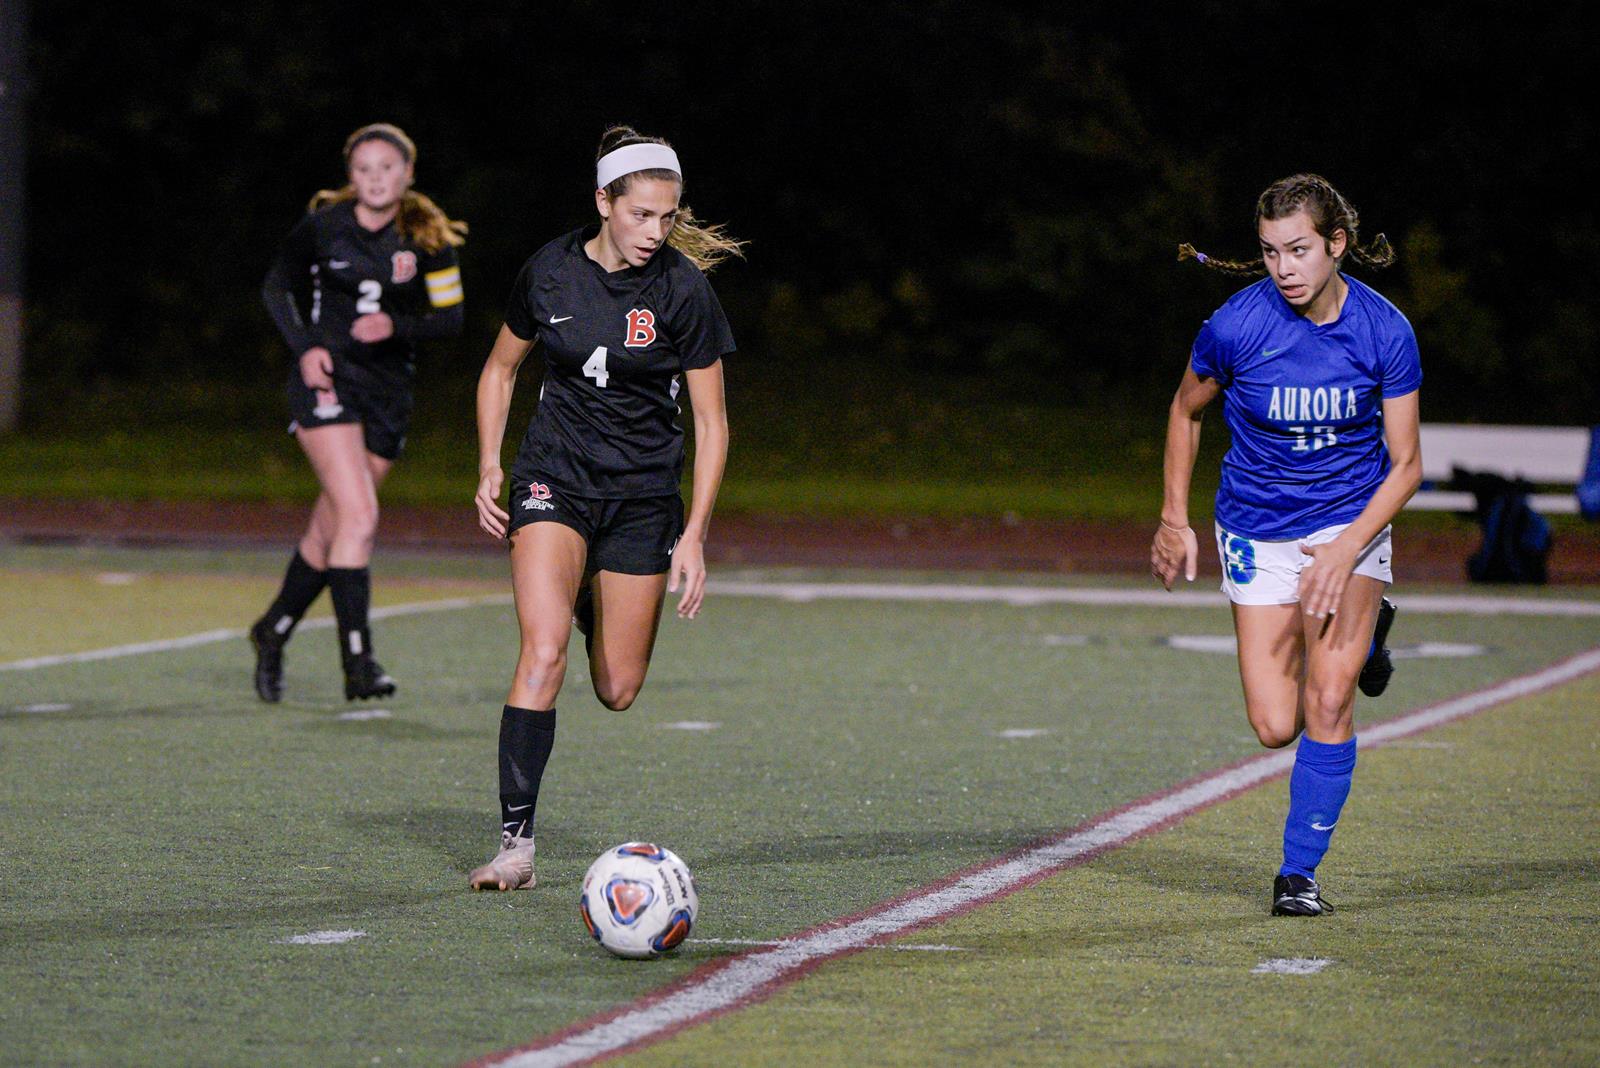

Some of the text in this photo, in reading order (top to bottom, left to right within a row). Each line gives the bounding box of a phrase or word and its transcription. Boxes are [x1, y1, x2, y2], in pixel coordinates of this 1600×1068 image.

[391, 251, 418, 284] B
[356, 279, 382, 314] 2
[624, 308, 656, 347] B
[582, 346, 609, 388] 4
[1267, 386, 1357, 421] AURORA
